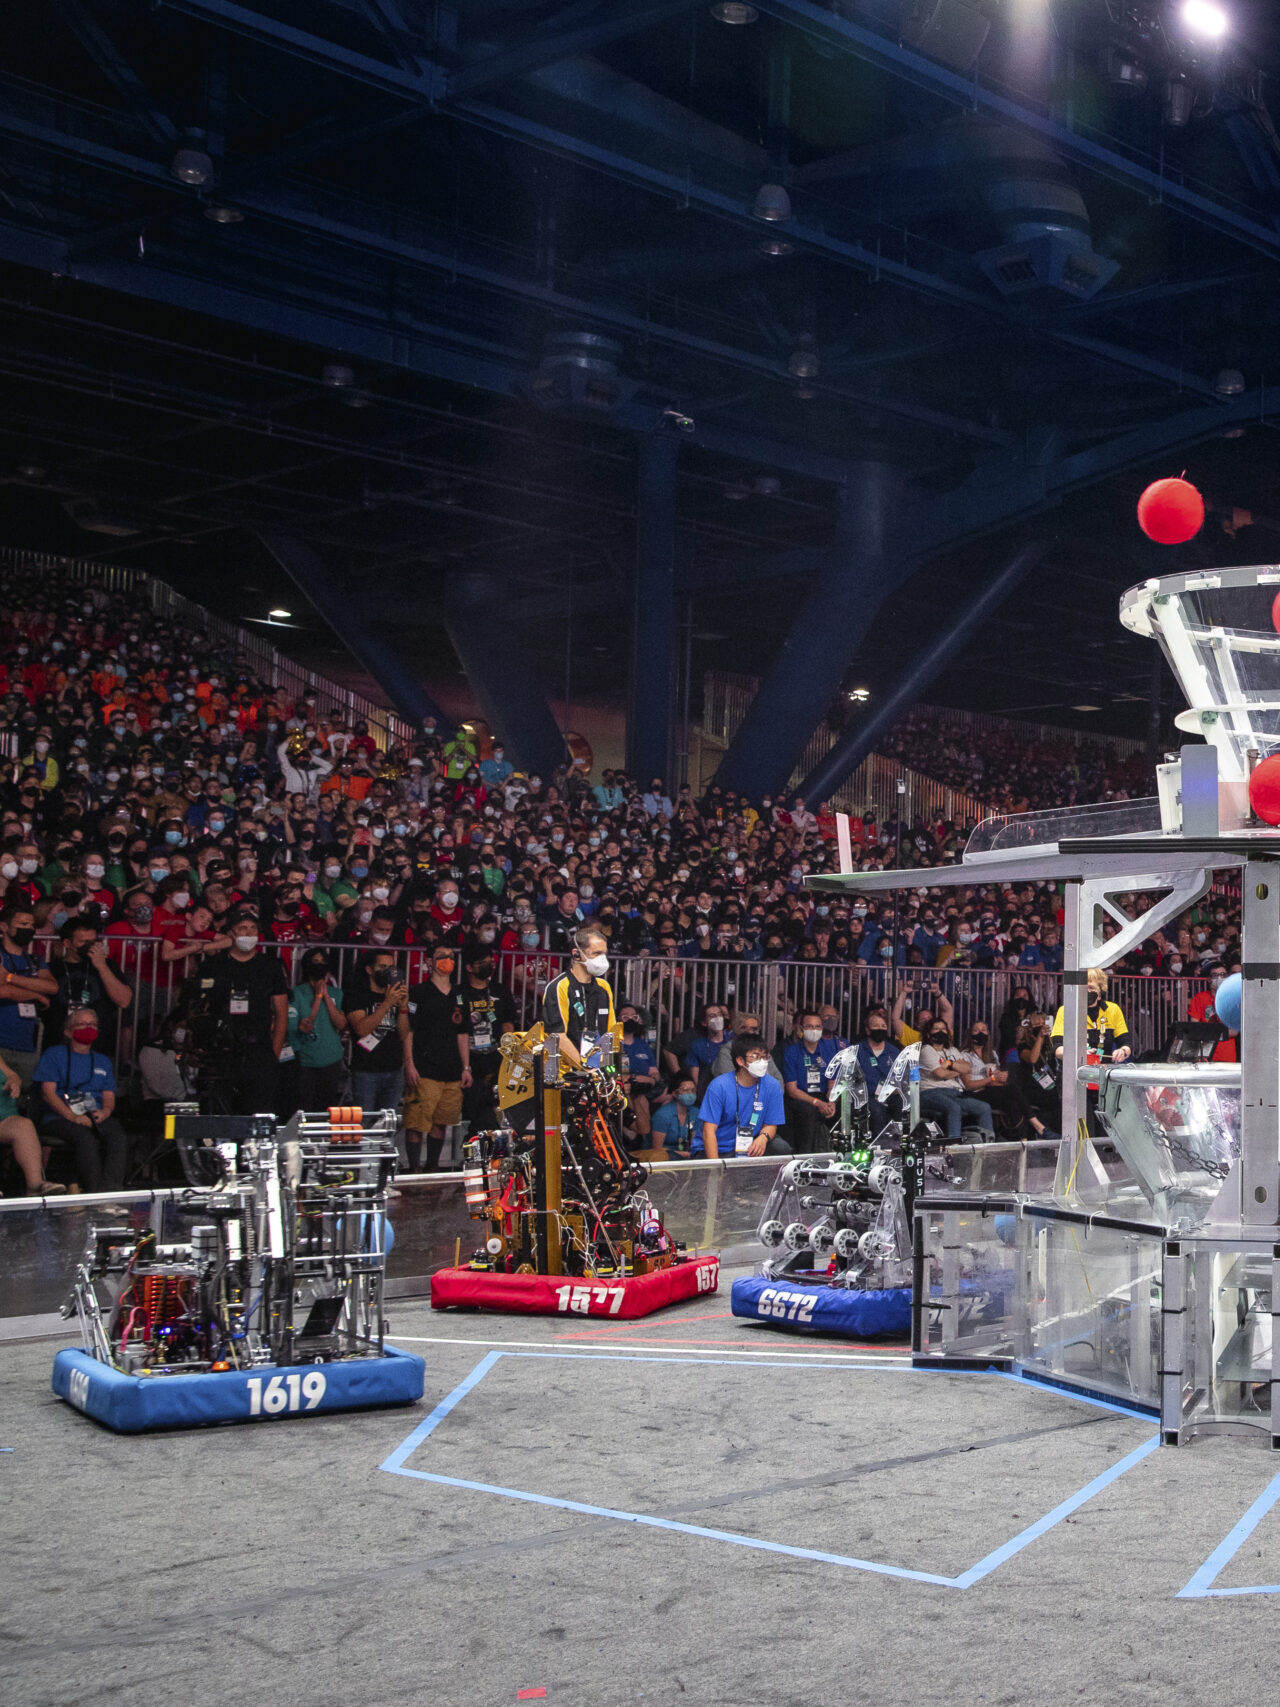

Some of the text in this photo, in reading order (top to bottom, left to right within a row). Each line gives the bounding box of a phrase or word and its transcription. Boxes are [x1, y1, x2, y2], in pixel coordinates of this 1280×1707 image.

[555, 1284, 626, 1315] 1577
[757, 1288, 819, 1322] 6672
[246, 1371, 327, 1415] 1619
